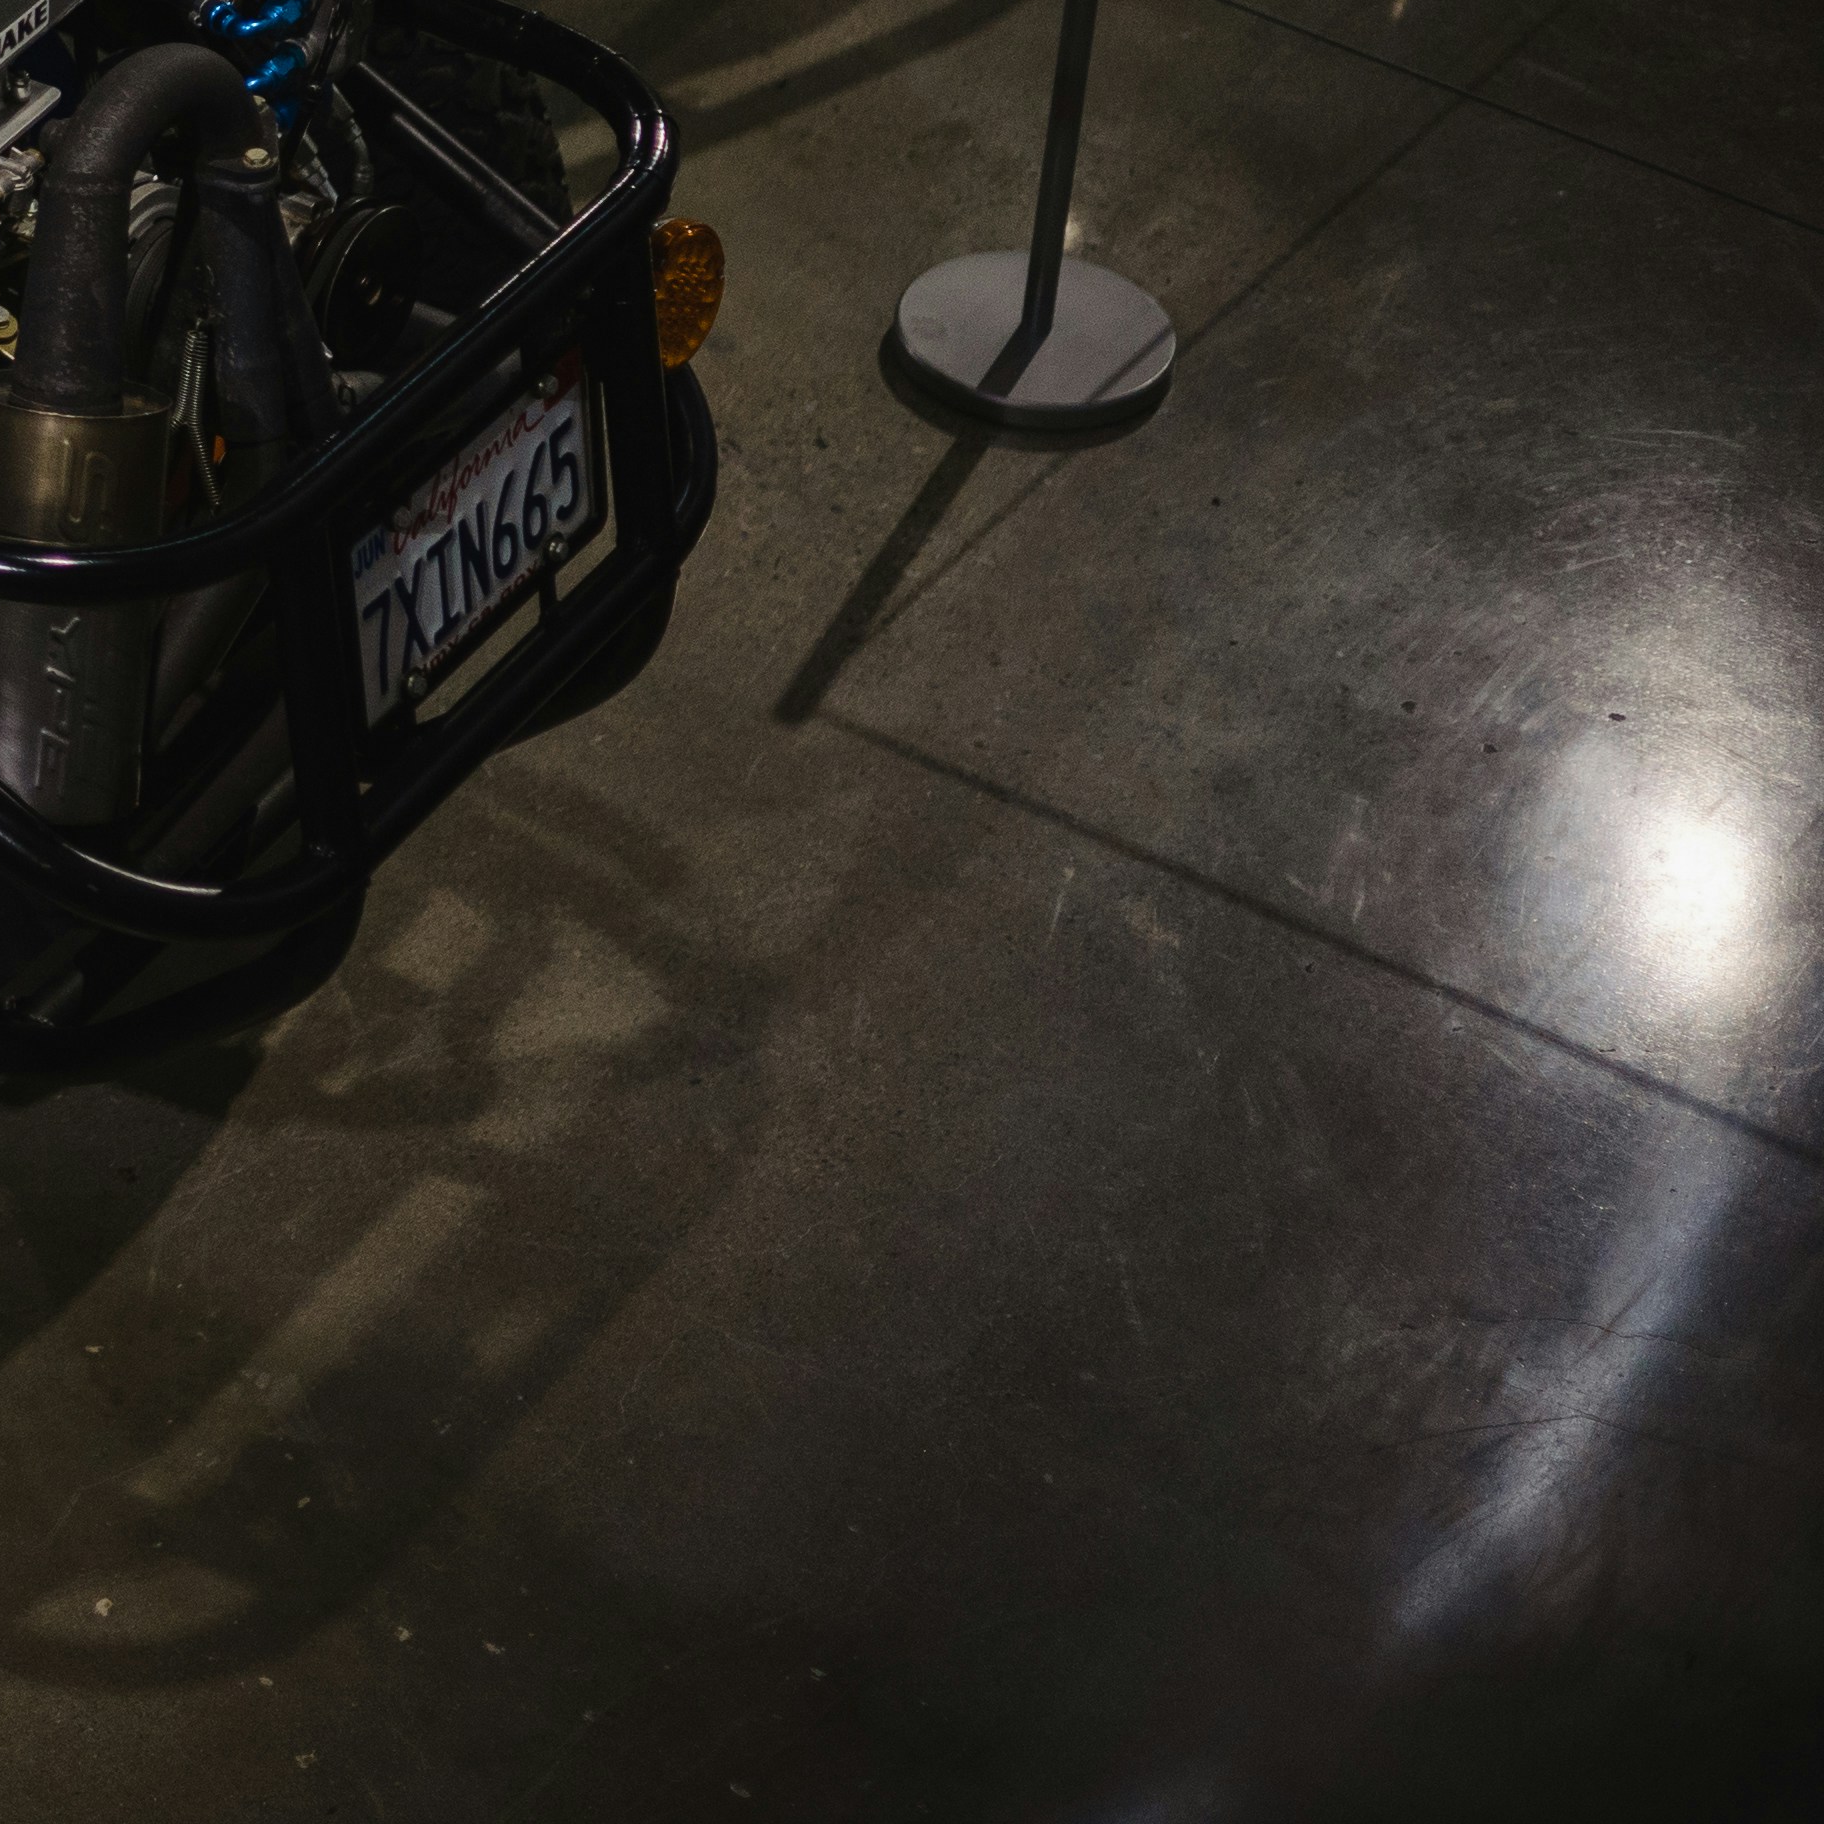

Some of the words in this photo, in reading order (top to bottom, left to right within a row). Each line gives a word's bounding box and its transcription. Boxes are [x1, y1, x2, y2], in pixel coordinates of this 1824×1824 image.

[354, 529, 387, 579] JUN
[362, 417, 581, 696] 7XIN665
[393, 408, 545, 557] California
